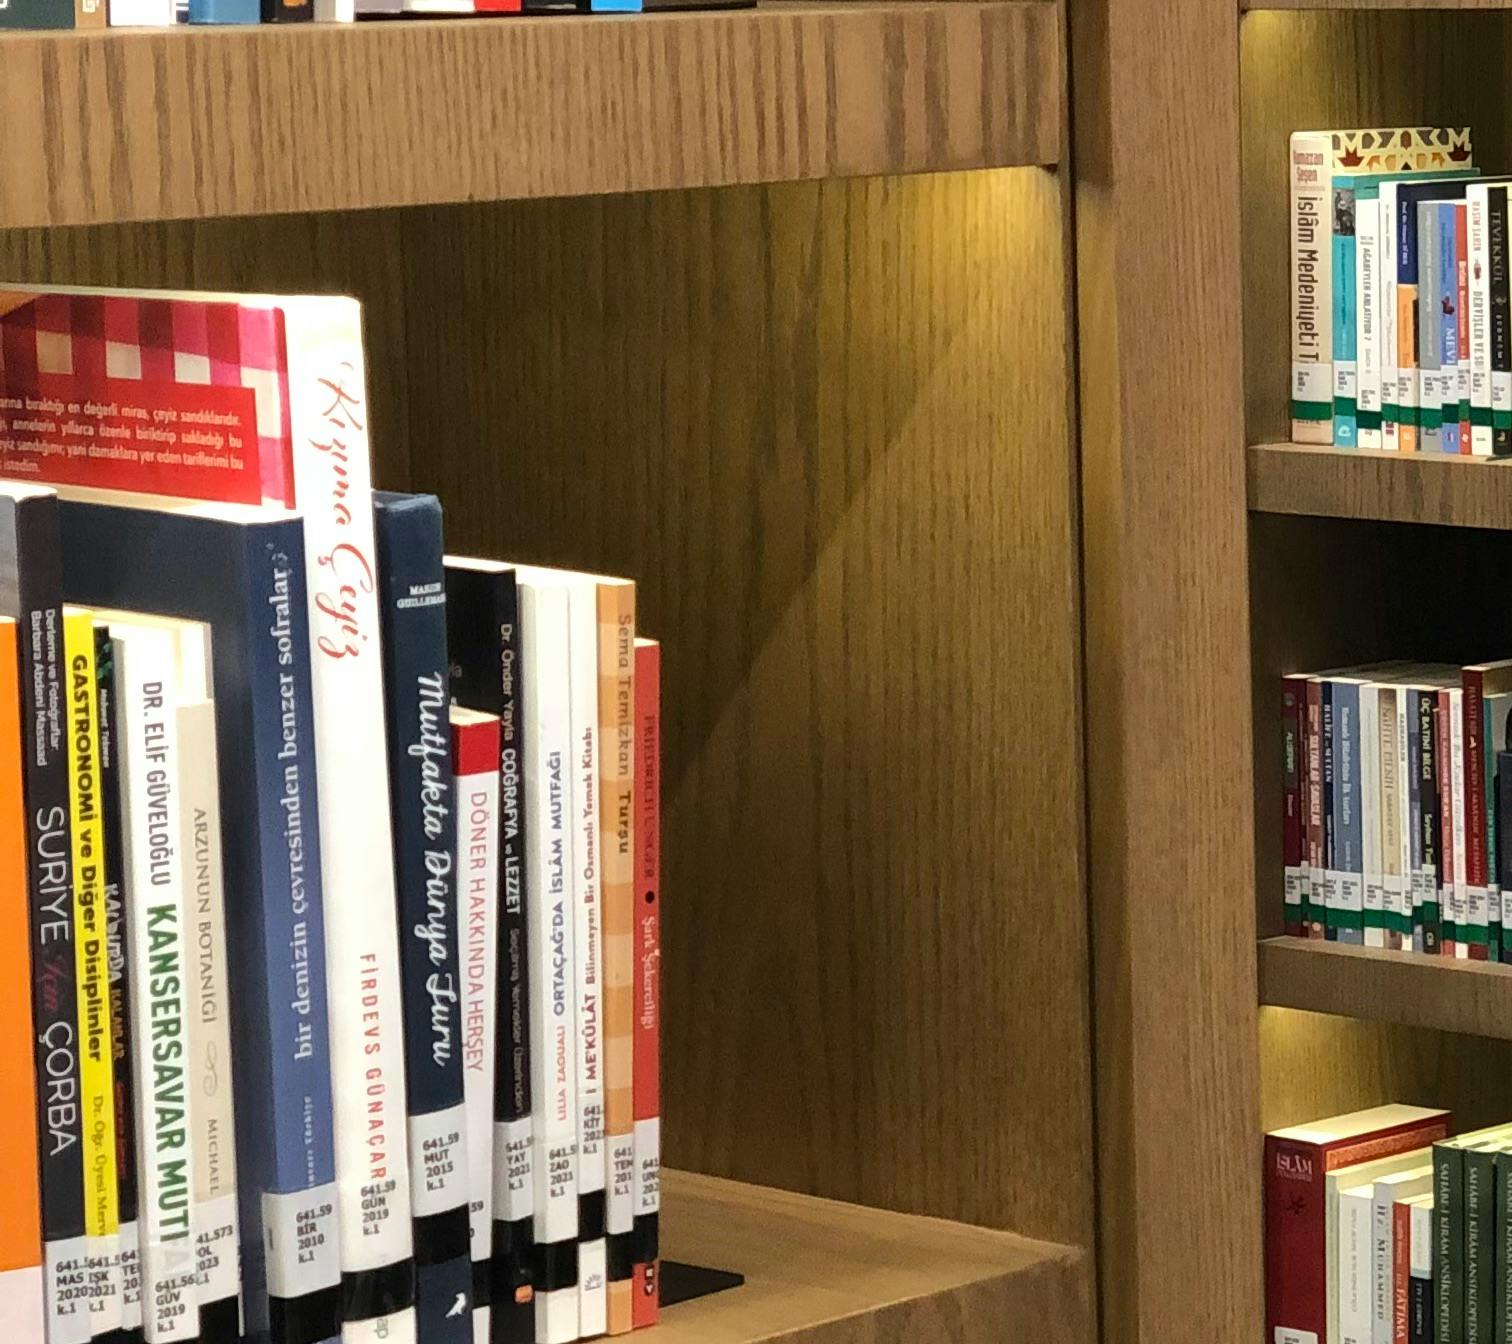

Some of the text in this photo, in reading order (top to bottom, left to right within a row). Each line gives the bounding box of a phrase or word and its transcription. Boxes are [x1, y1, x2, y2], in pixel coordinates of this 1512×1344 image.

[1295, 196, 1322, 347] İslâm Medeniyeti
[142, 680, 174, 887] DR. ELİF GÜVELOĞLU
[545, 750, 563, 832] MUTFAĞI
[617, 614, 634, 777] Sema Temizkan
[71, 653, 103, 1064] GASTRONOMİ ve Diğer Disiplinler
[193, 807, 212, 916] ARZUNUN
[269, 568, 313, 1062] bir denizin çevresinden benzer sofralar
[406, 670, 451, 967] Mutfakta Dünya
[466, 790, 489, 996] DÖNER HAKKINDA
[500, 748, 521, 915] COĞRAFYA LEZZET
[36, 805, 78, 1158] SURİYE ÇORBA
[147, 903, 187, 1154] KANSERSAVAR
[360, 952, 388, 1179] FİRDEVS GÜNAÇAR
